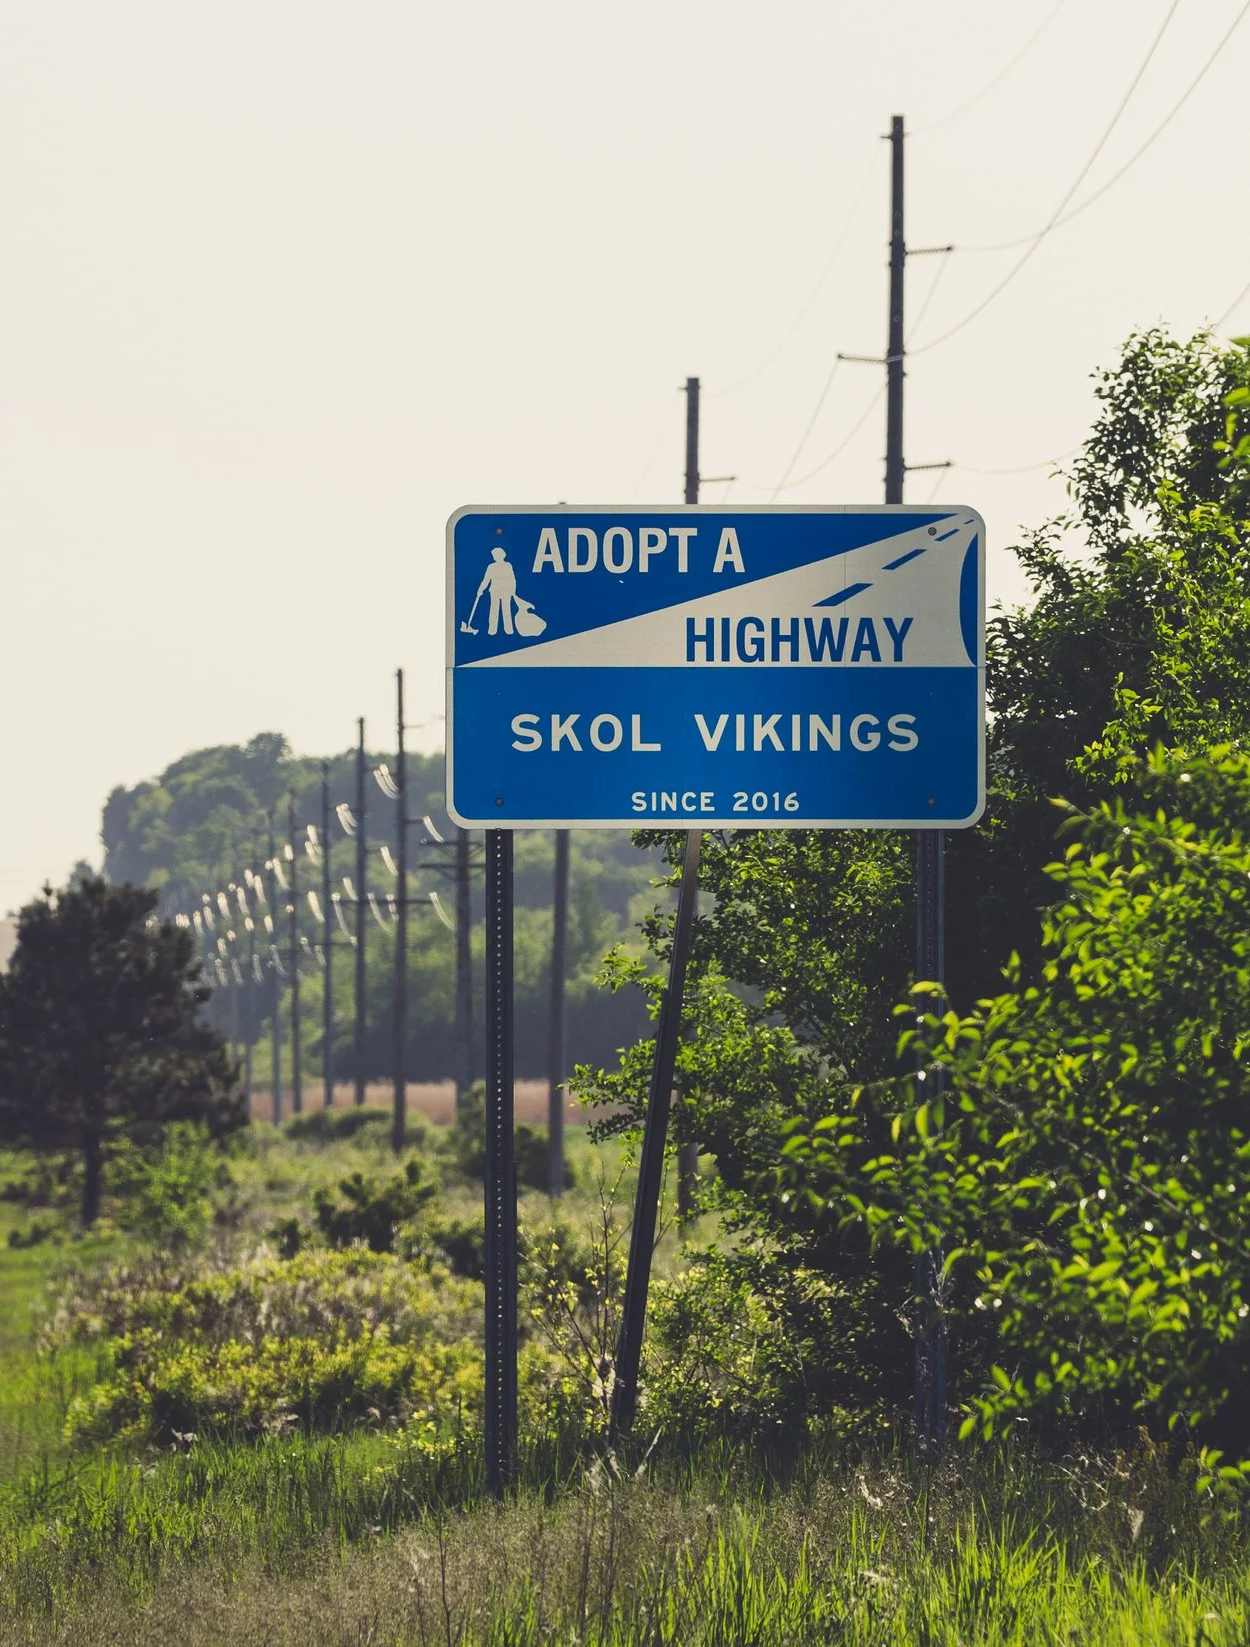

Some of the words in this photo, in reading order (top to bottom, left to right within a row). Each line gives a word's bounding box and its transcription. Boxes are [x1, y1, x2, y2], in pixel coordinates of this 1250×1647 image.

[532, 527, 698, 574] ADOPT
[713, 527, 746, 573] A
[685, 616, 914, 663] HIGHWAY
[511, 713, 662, 752] SKOL
[694, 713, 920, 752] VIKINGS
[631, 791, 716, 812] SINCE
[732, 791, 801, 812] 2016
